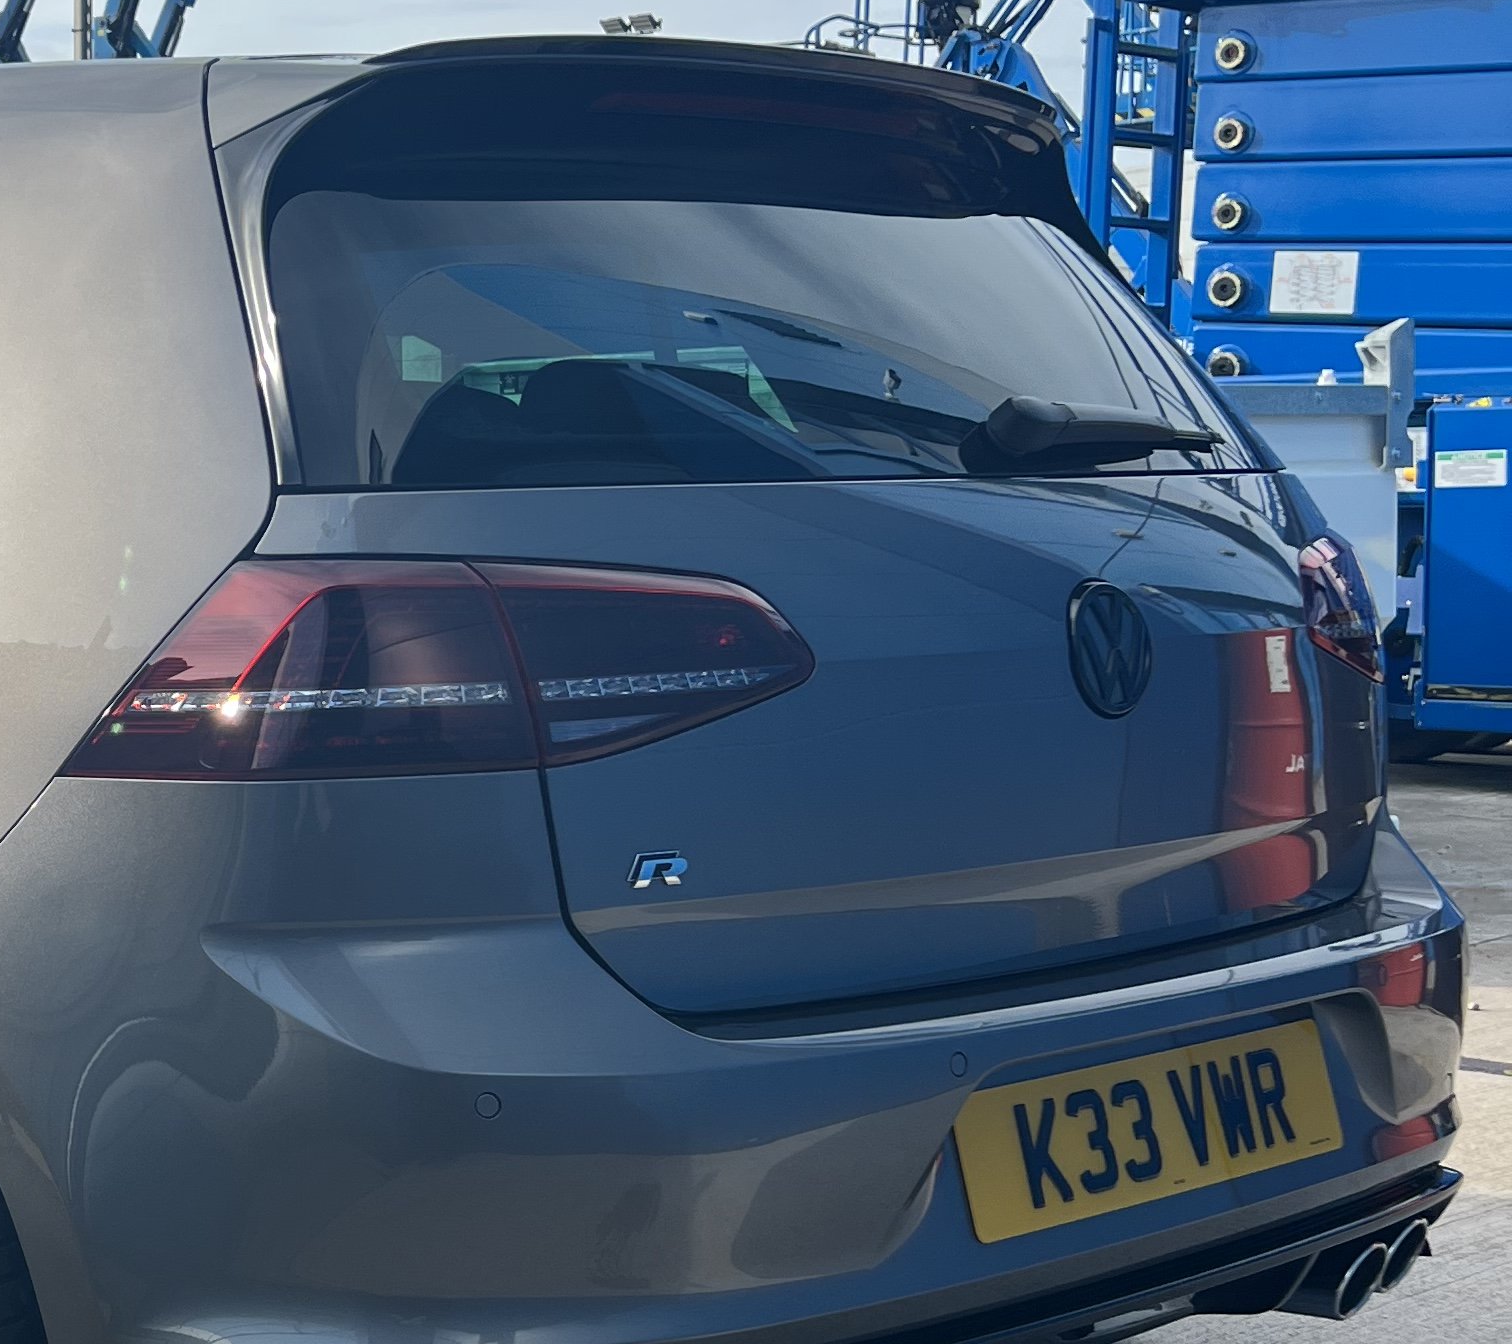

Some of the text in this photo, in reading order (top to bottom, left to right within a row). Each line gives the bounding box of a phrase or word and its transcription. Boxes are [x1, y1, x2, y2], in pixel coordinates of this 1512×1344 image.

[630, 854, 688, 889] R
[1013, 1048, 1296, 1209] K33 VWR
